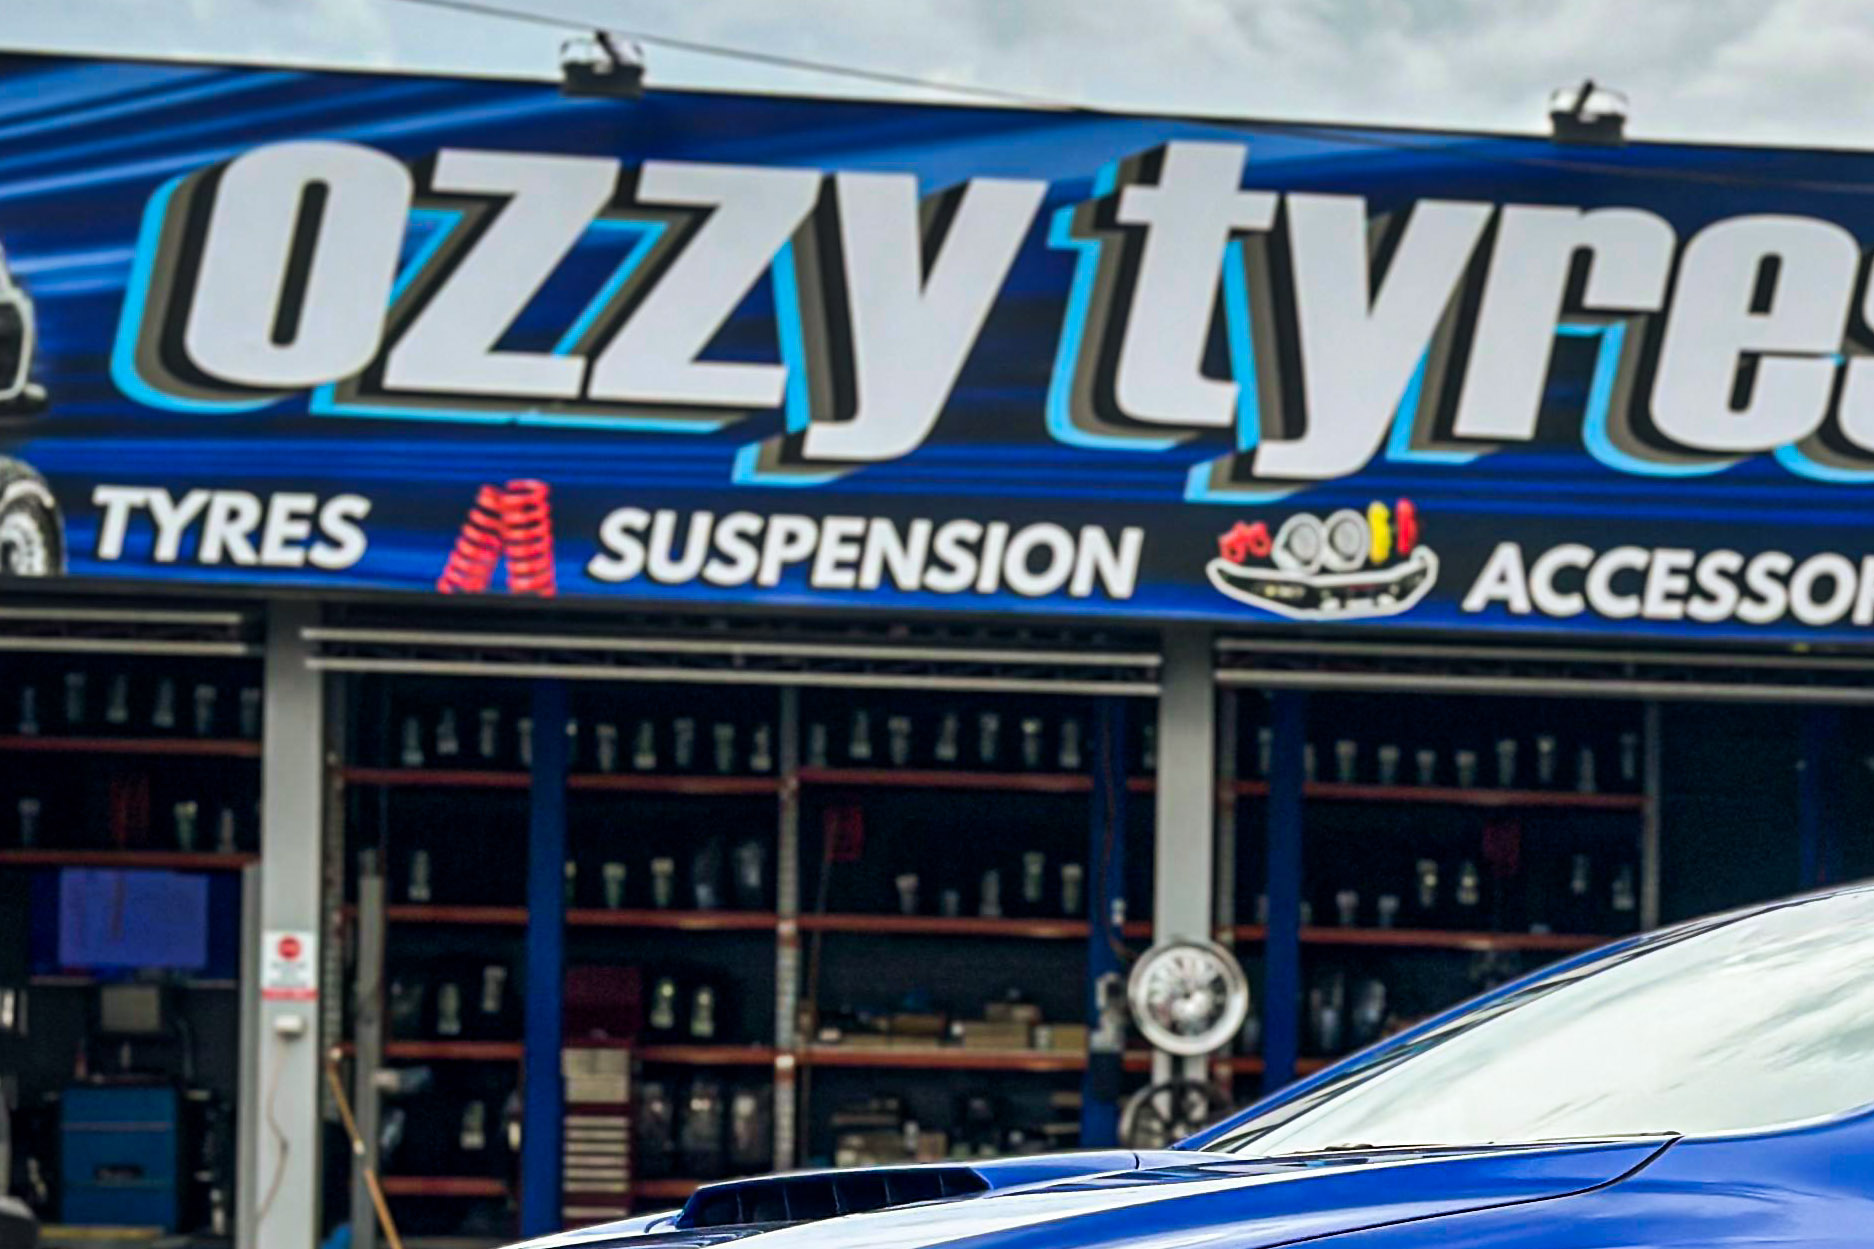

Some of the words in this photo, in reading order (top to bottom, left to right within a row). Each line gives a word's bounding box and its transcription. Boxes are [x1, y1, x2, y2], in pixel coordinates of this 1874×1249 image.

[183, 138, 1050, 462] ozzy
[91, 484, 372, 570] TYRES
[587, 505, 1145, 600] SUSPENSION
